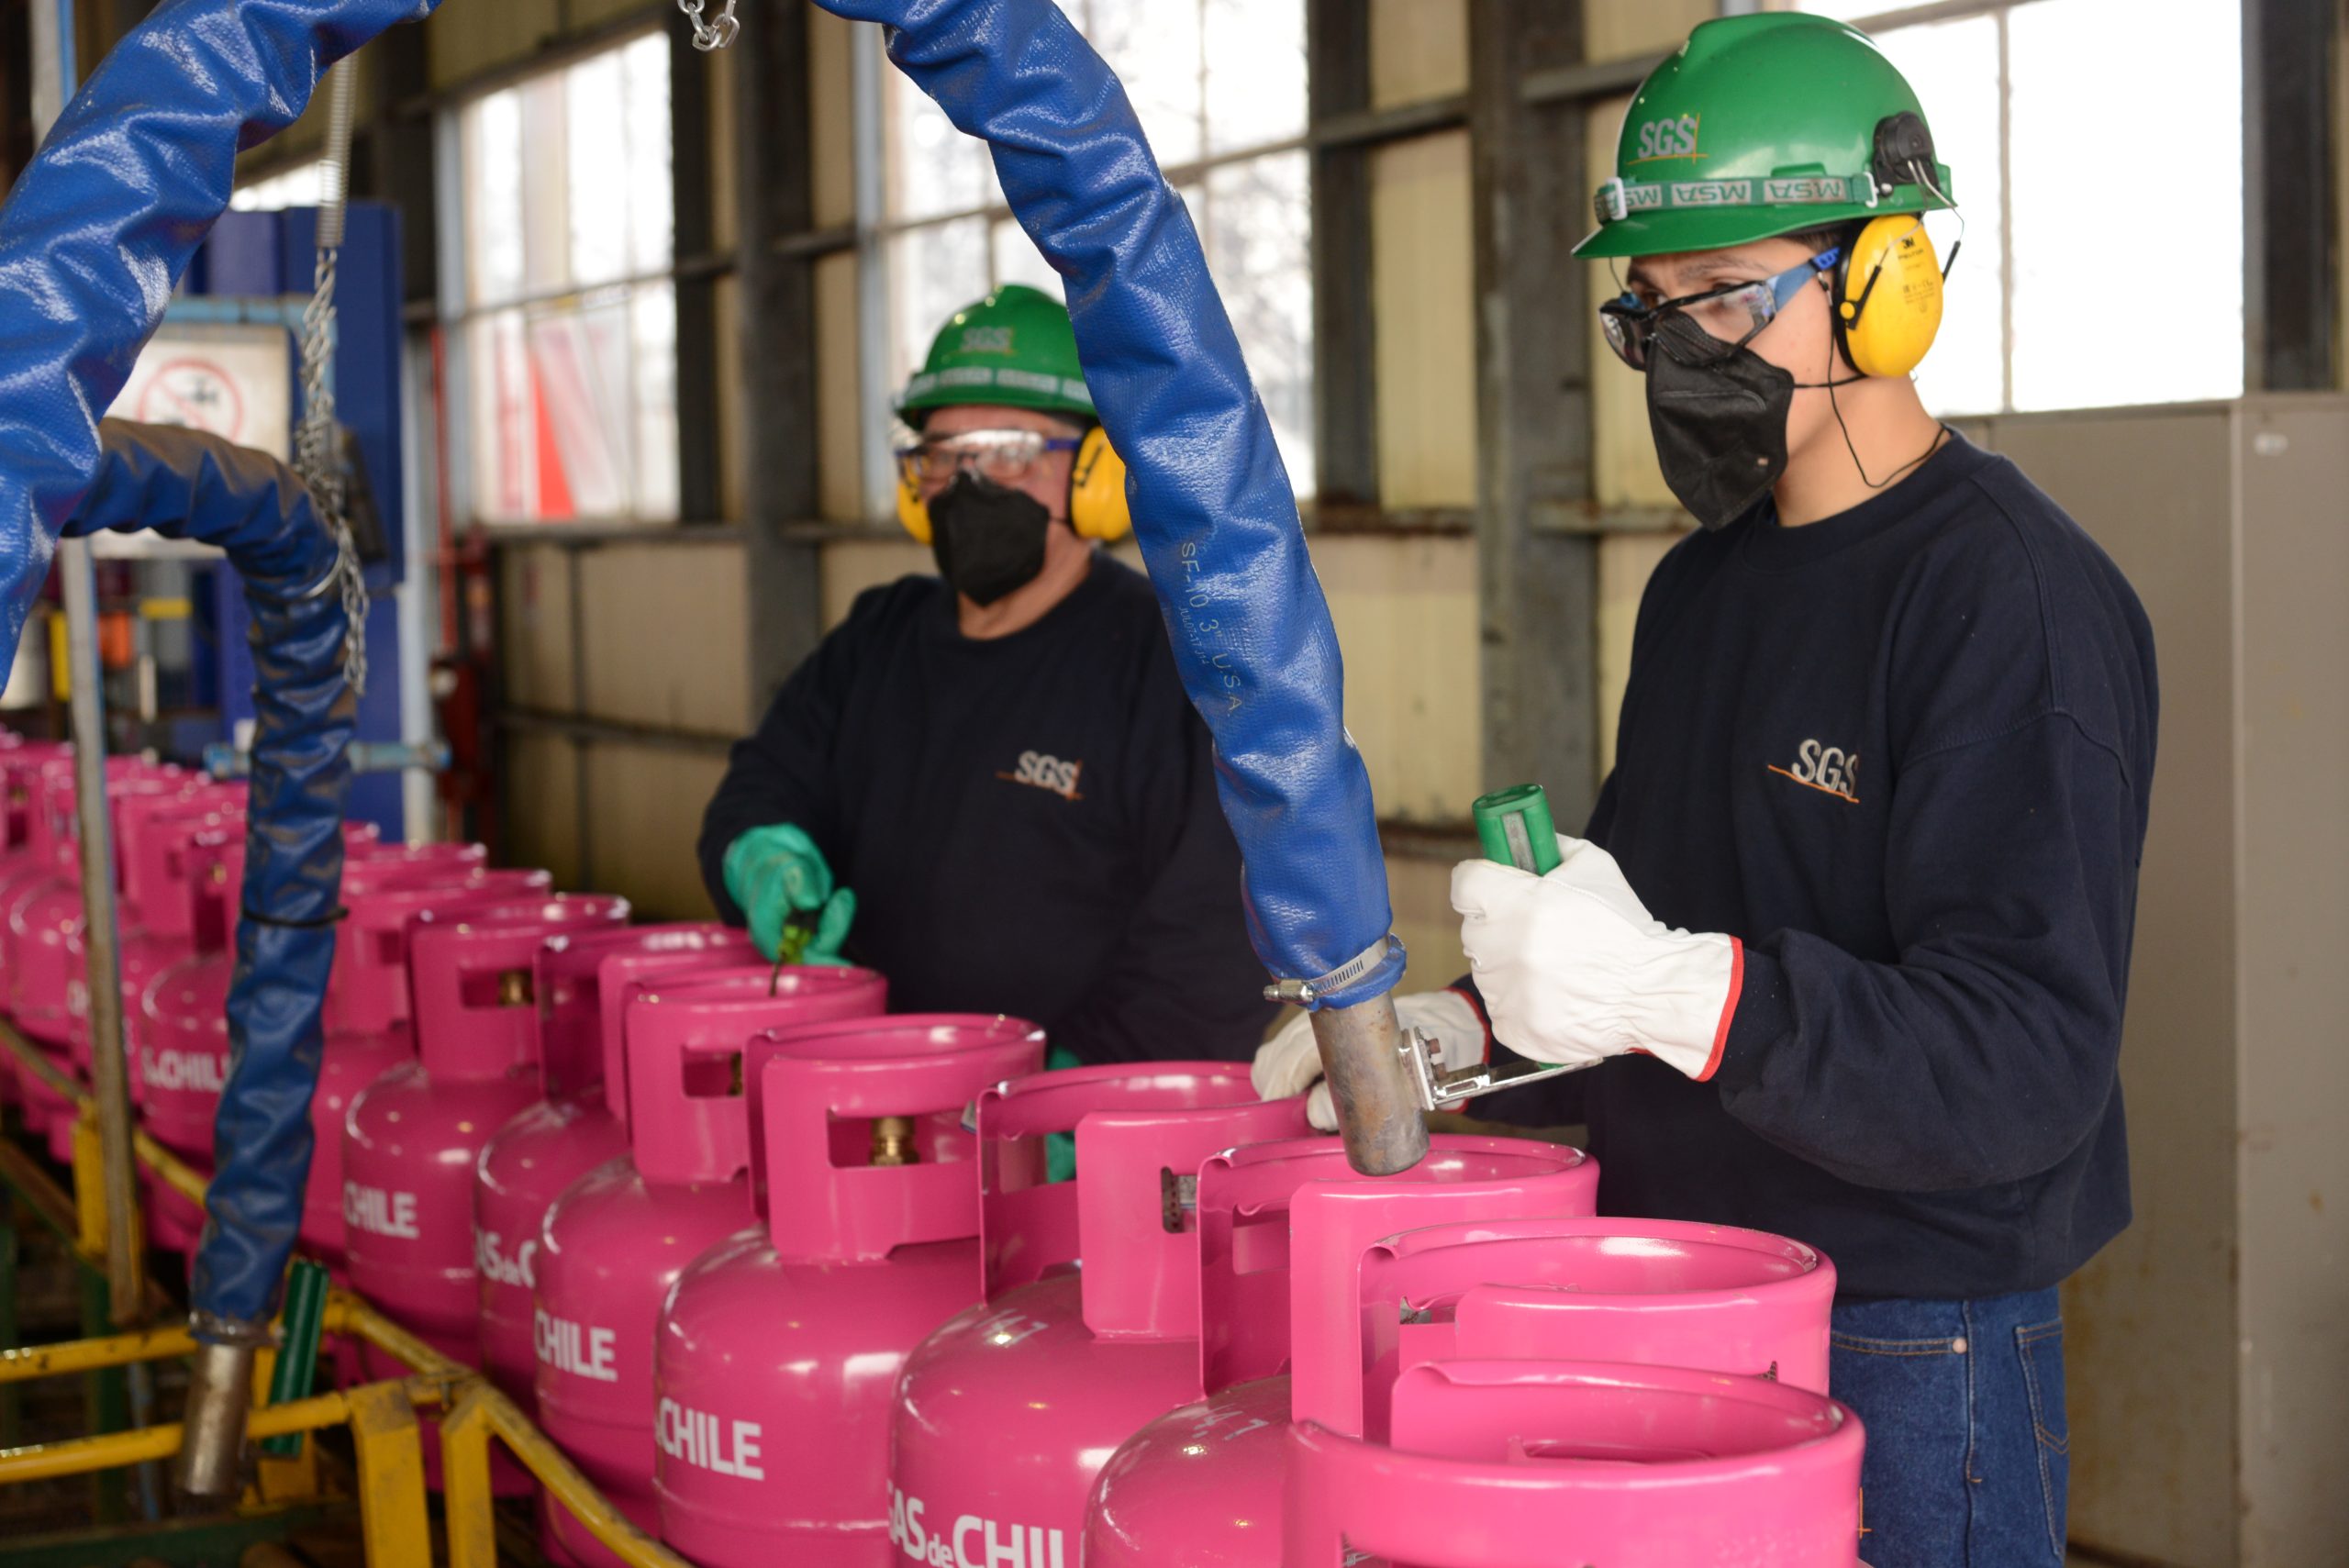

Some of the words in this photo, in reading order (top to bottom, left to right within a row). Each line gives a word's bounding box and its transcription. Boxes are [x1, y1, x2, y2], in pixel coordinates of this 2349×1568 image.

[1638, 117, 1696, 159] SGS
[1675, 183, 1746, 203] MSA
[1768, 180, 1841, 200] MSA
[960, 326, 1012, 352] SGS
[1014, 751, 1080, 795] SGS
[1792, 739, 1859, 798] SGS
[345, 1180, 420, 1240] CHILE
[534, 1308, 618, 1382] CHILE
[659, 1396, 764, 1481] CHILE
